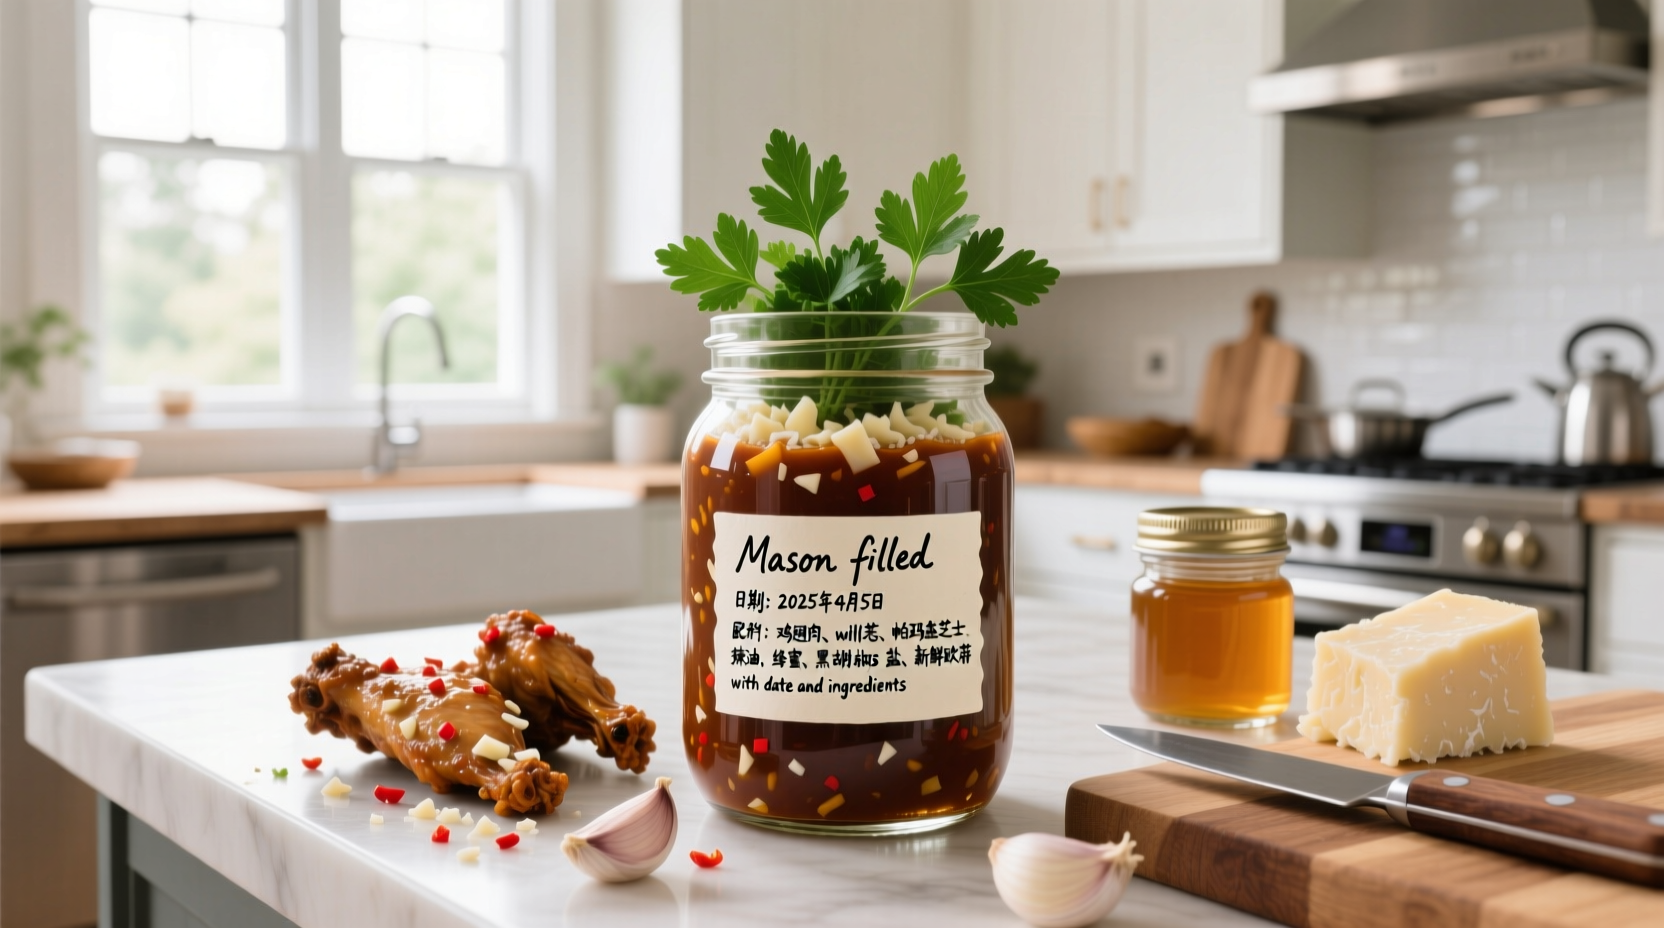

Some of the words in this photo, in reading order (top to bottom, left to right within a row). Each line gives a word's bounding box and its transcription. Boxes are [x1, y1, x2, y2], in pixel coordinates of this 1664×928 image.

[735, 534, 838, 574] Mason
[849, 532, 934, 587] filled
[777, 590, 884, 614] 2025年4月5日
[731, 673, 760, 691] with
[763, 675, 794, 693] date
[797, 676, 824, 694] and
[828, 675, 907, 700] ingredients
